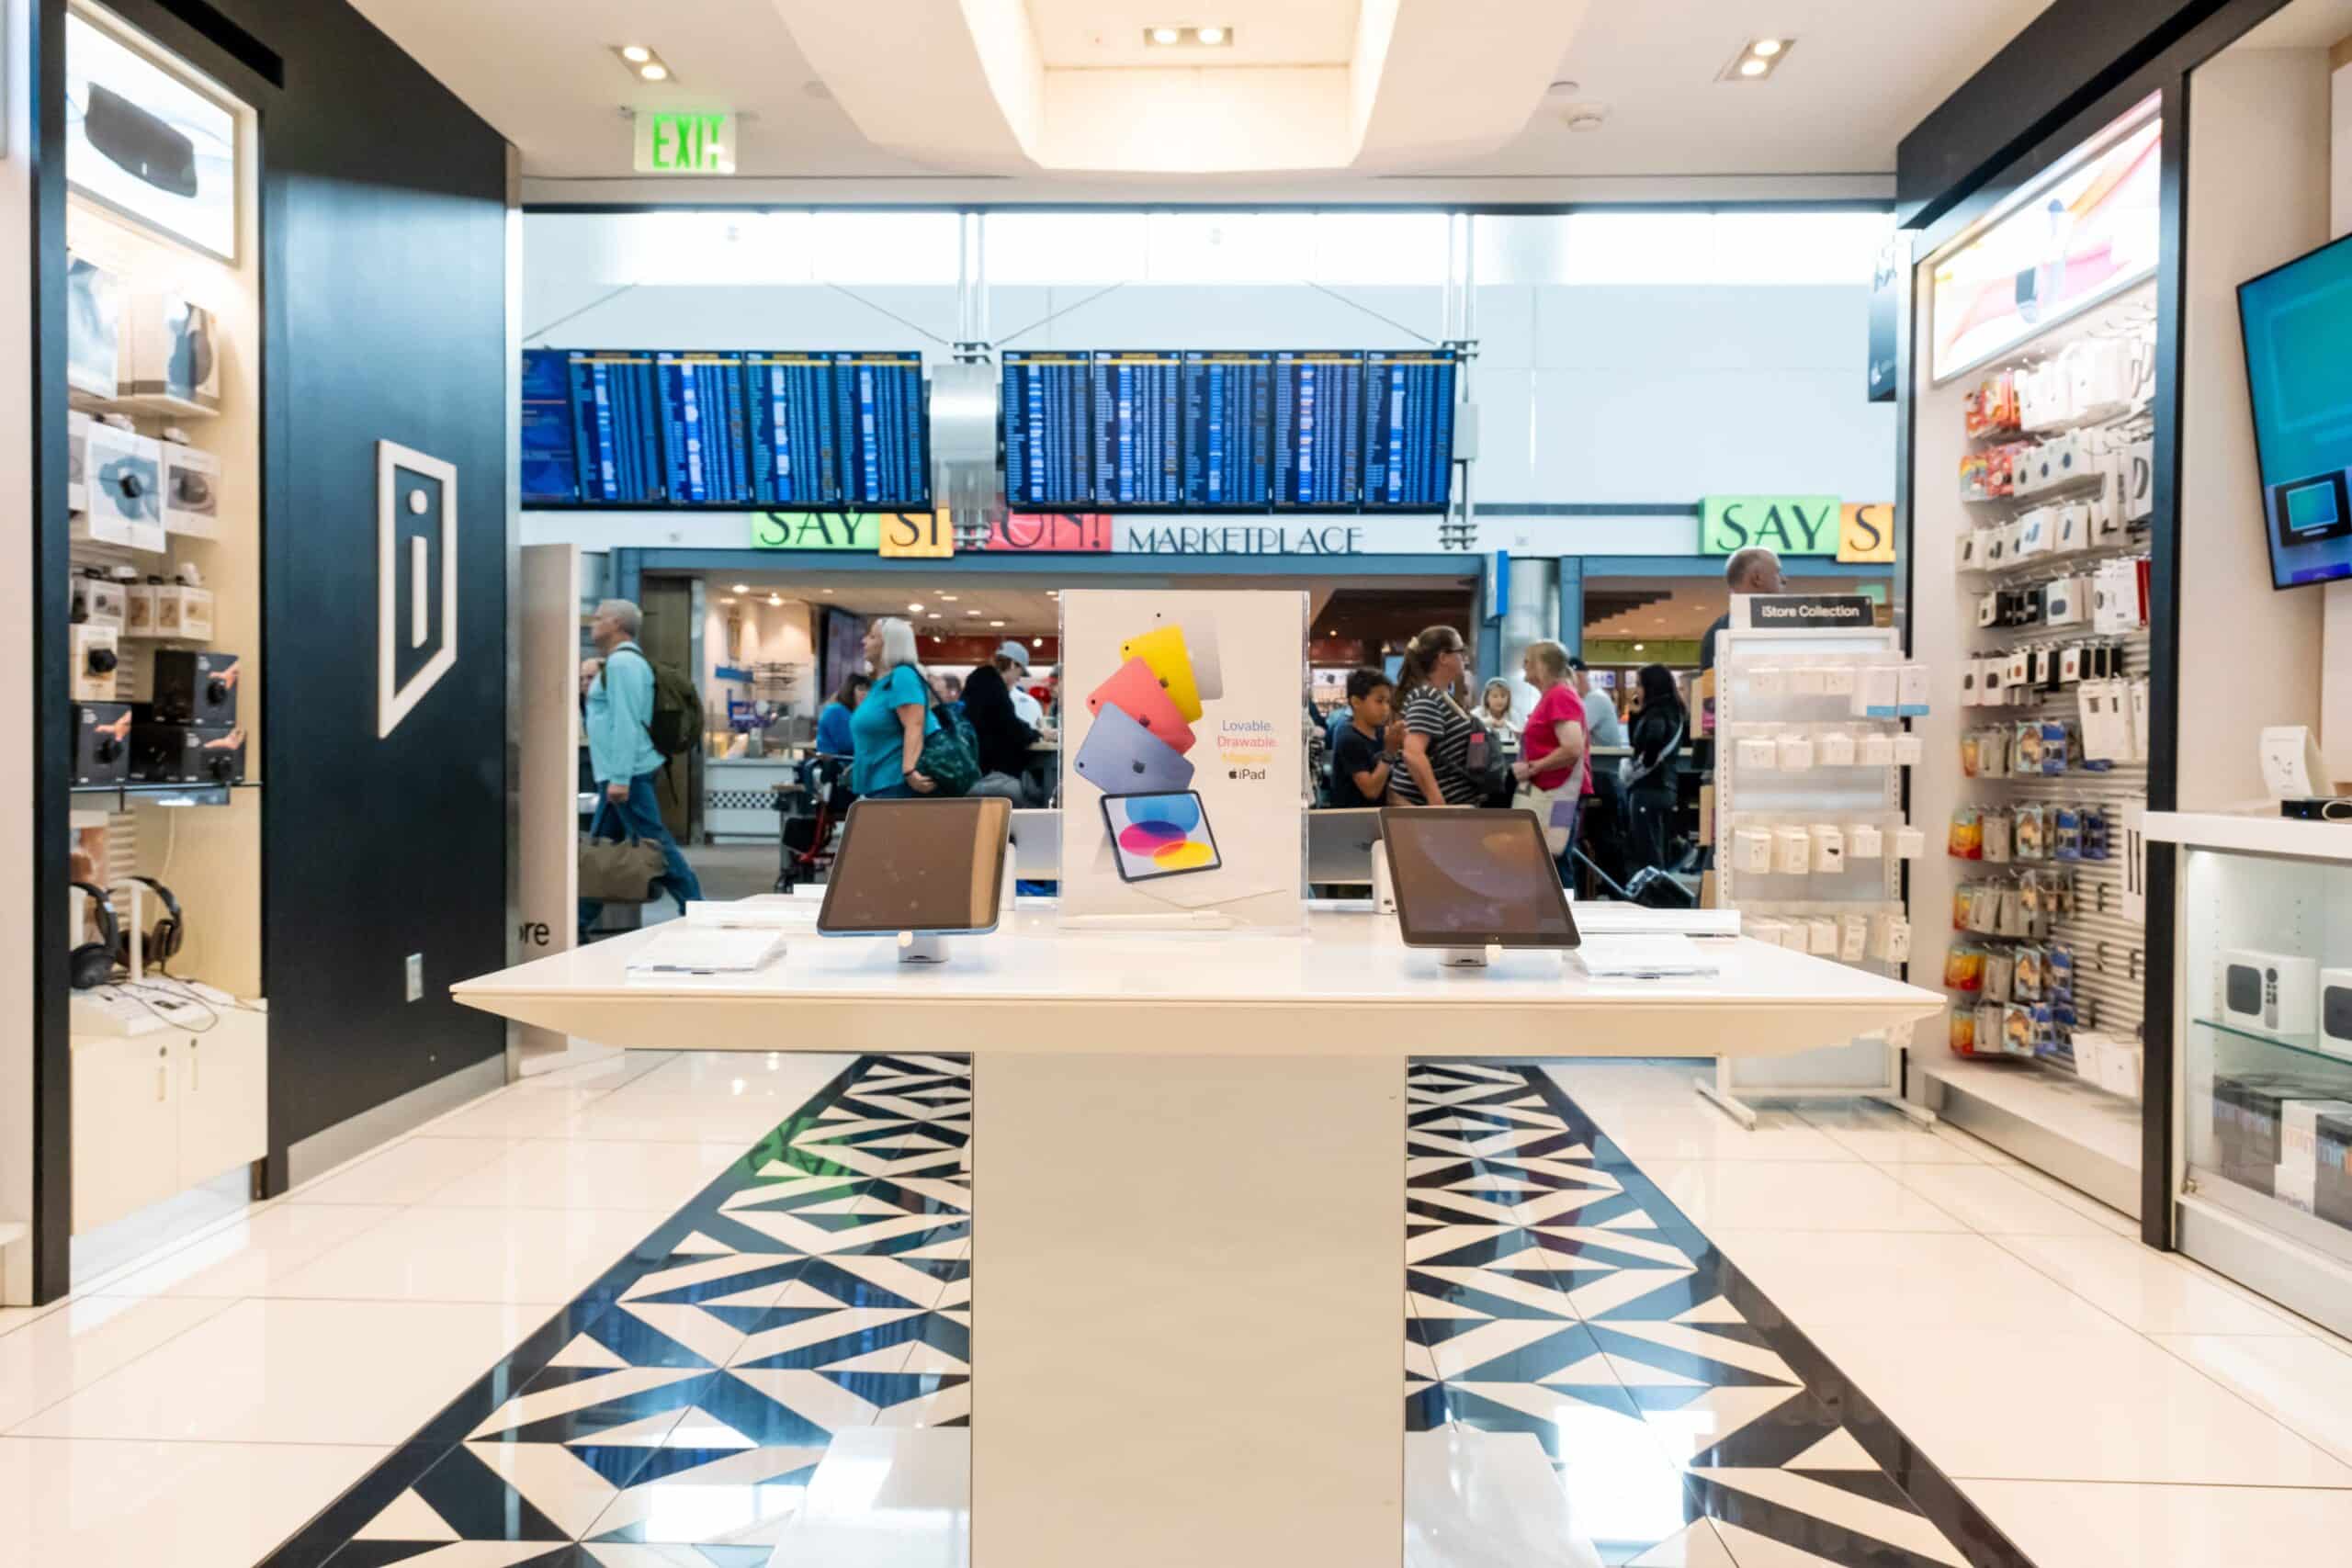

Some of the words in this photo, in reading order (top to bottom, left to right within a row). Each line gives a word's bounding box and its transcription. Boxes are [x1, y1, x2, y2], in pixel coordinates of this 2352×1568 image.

[652, 114, 726, 169] EXIT
[761, 512, 863, 546] SAY
[981, 509, 1101, 548] ON!
[1128, 526, 1364, 553] MARKETPLACE
[1716, 504, 1830, 551] SAY
[1761, 605, 1797, 618] iStore
[1799, 604, 1860, 618] Collection
[1238, 769, 1266, 780] iPad
